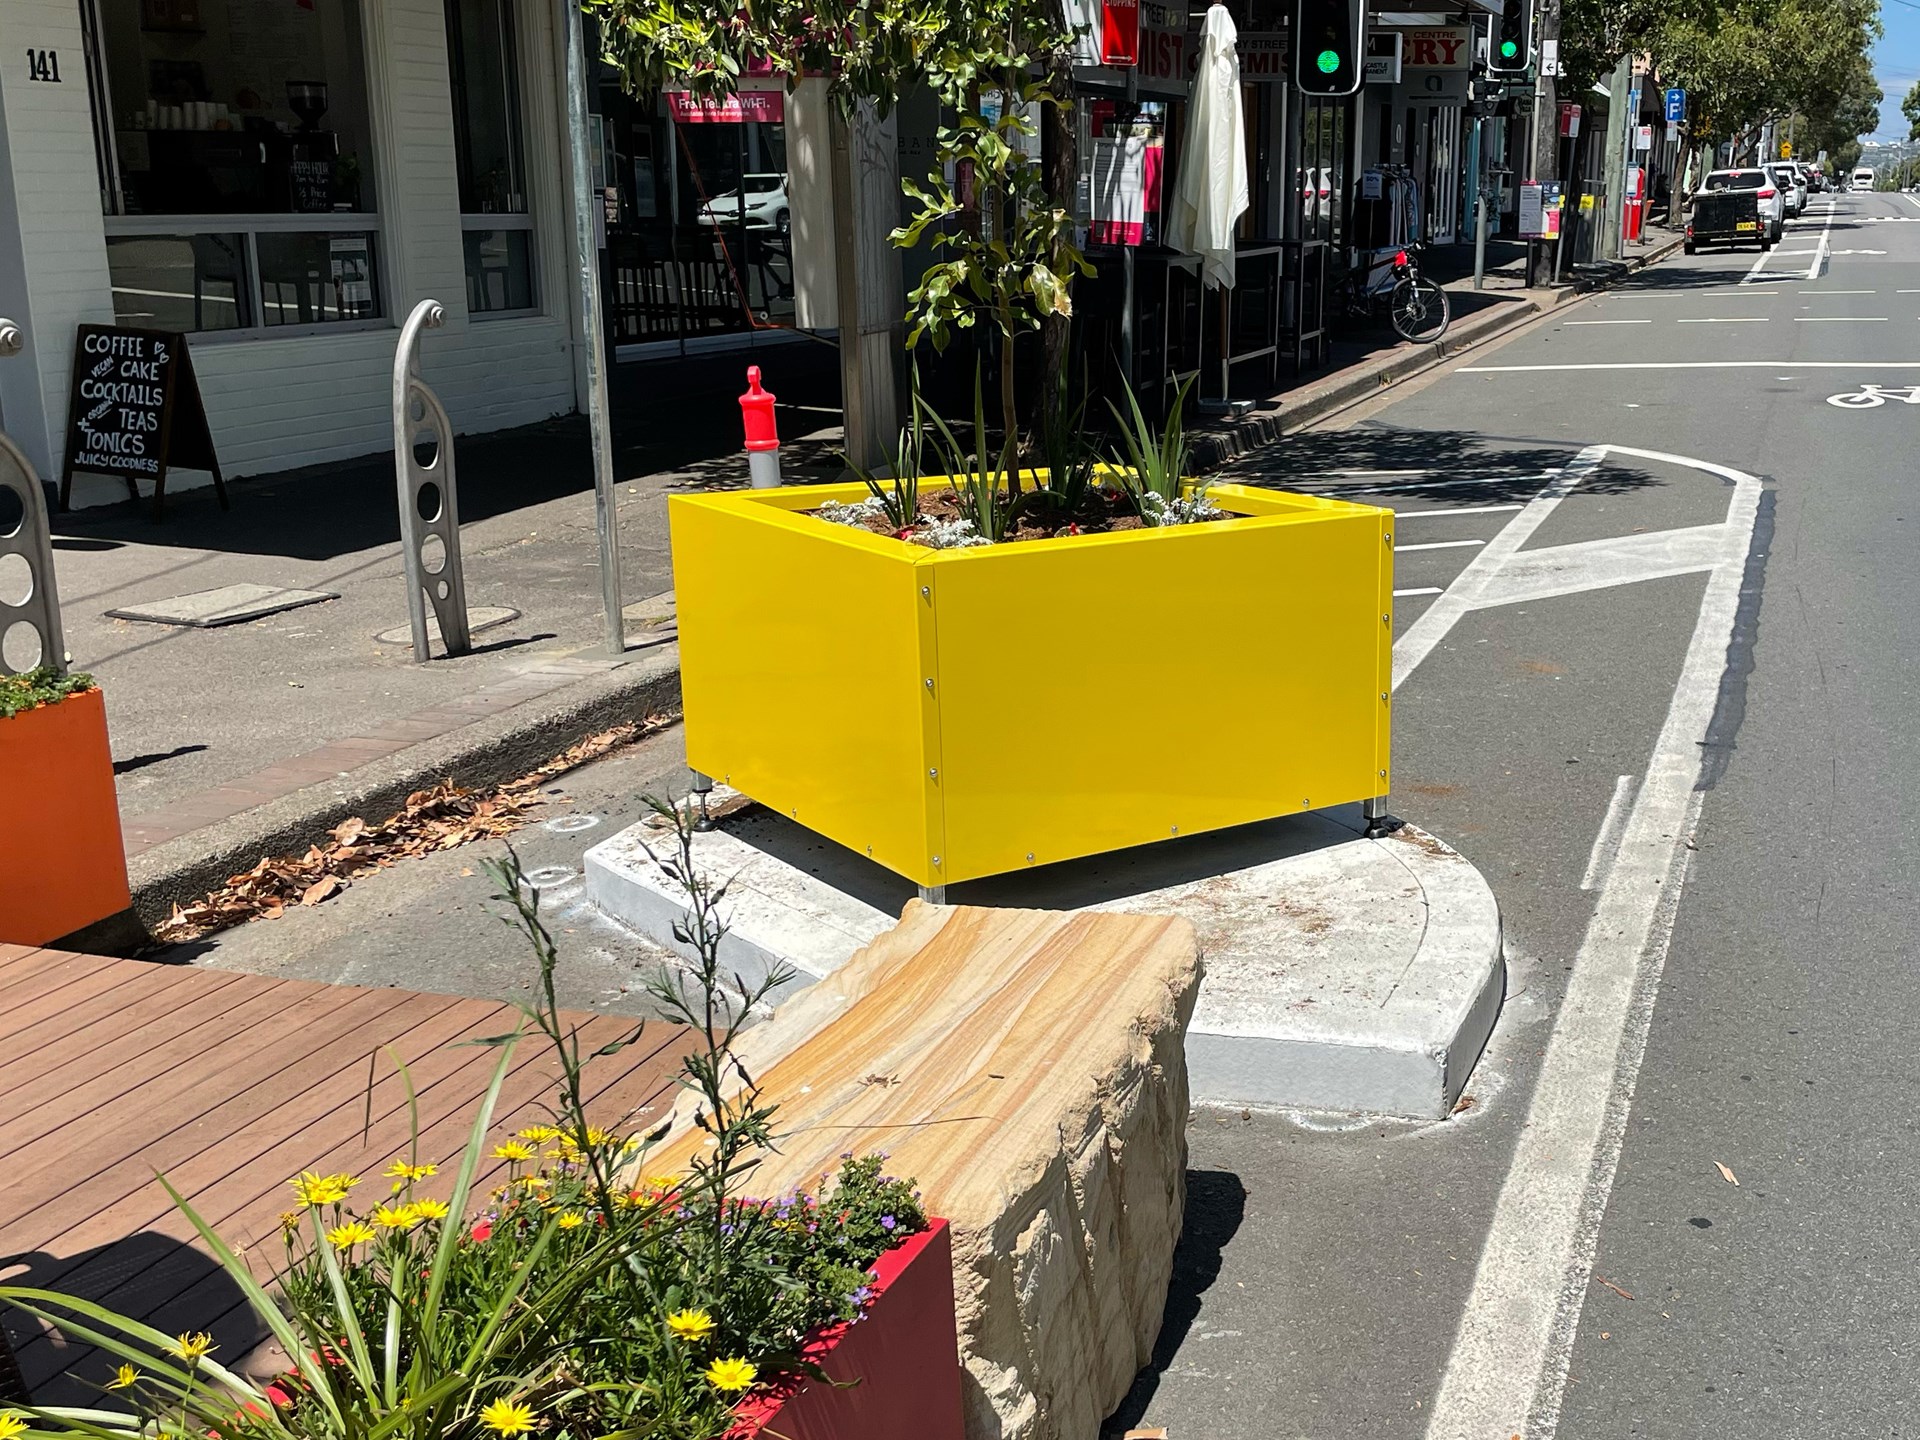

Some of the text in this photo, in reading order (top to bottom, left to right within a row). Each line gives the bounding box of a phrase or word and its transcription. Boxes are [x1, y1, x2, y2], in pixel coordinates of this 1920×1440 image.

[1139, 1, 1166, 25] TREET
[1413, 31, 1457, 39] CENTRE
[26, 48, 62, 83] 141
[703, 98, 739, 109] Telra
[898, 136, 935, 148] BAN
[84, 334, 144, 357] COFFEE
[91, 355, 160, 381] VEGAN CAKE
[80, 379, 163, 406] COCKTAILS
[118, 408, 158, 432] TEAS
[84, 428, 145, 455] TONICS
[75, 451, 159, 473] JUICY GOODNESS
